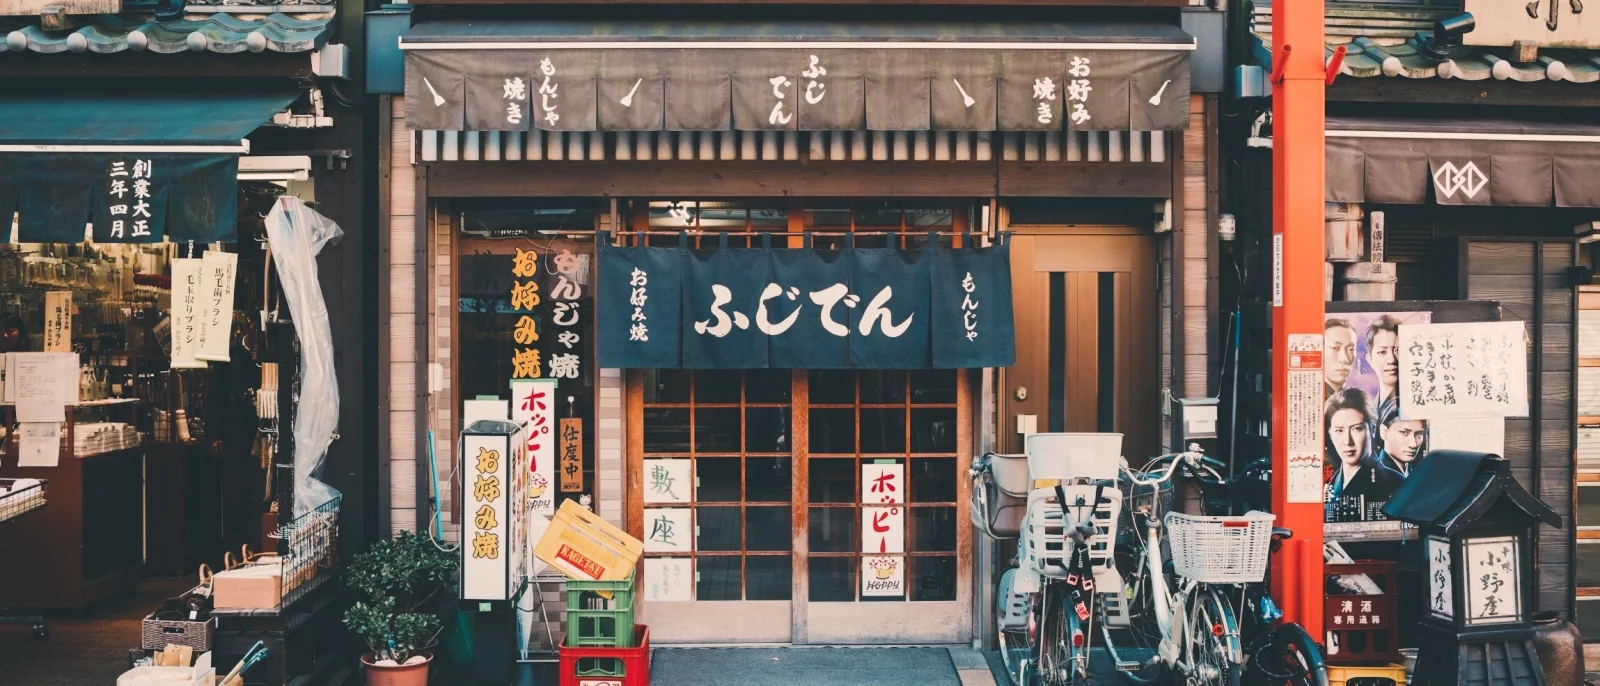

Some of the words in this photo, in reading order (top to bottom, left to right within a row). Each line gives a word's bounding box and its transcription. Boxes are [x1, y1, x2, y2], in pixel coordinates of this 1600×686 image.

[502, 77, 526, 124] 焼き
[539, 57, 560, 126] もんじゃ
[768, 75, 793, 125] でん
[802, 55, 826, 105] ふじ
[1032, 77, 1056, 124] 焼き
[1067, 56, 1093, 125] お好み
[109, 161, 129, 239] 三年四月
[131, 159, 152, 238] 創業大正
[184, 274, 195, 344] 毛玉取りブラシ
[212, 267, 225, 327] 馬毛歯ブラシ
[511, 247, 541, 379] お好み焼
[549, 249, 582, 379] もんじゃ焼
[629, 267, 649, 342] お好み焼
[694, 282, 915, 338] ふじでん
[961, 271, 979, 342] もんじゃ
[562, 424, 580, 480] 仕度中
[472, 447, 500, 560] お好み焼
[870, 470, 898, 553] ホッピー
[560, 546, 604, 575] KAGETSU
[1480, 550, 1504, 616] 小野屋
[1341, 600, 1373, 613] 清酒
